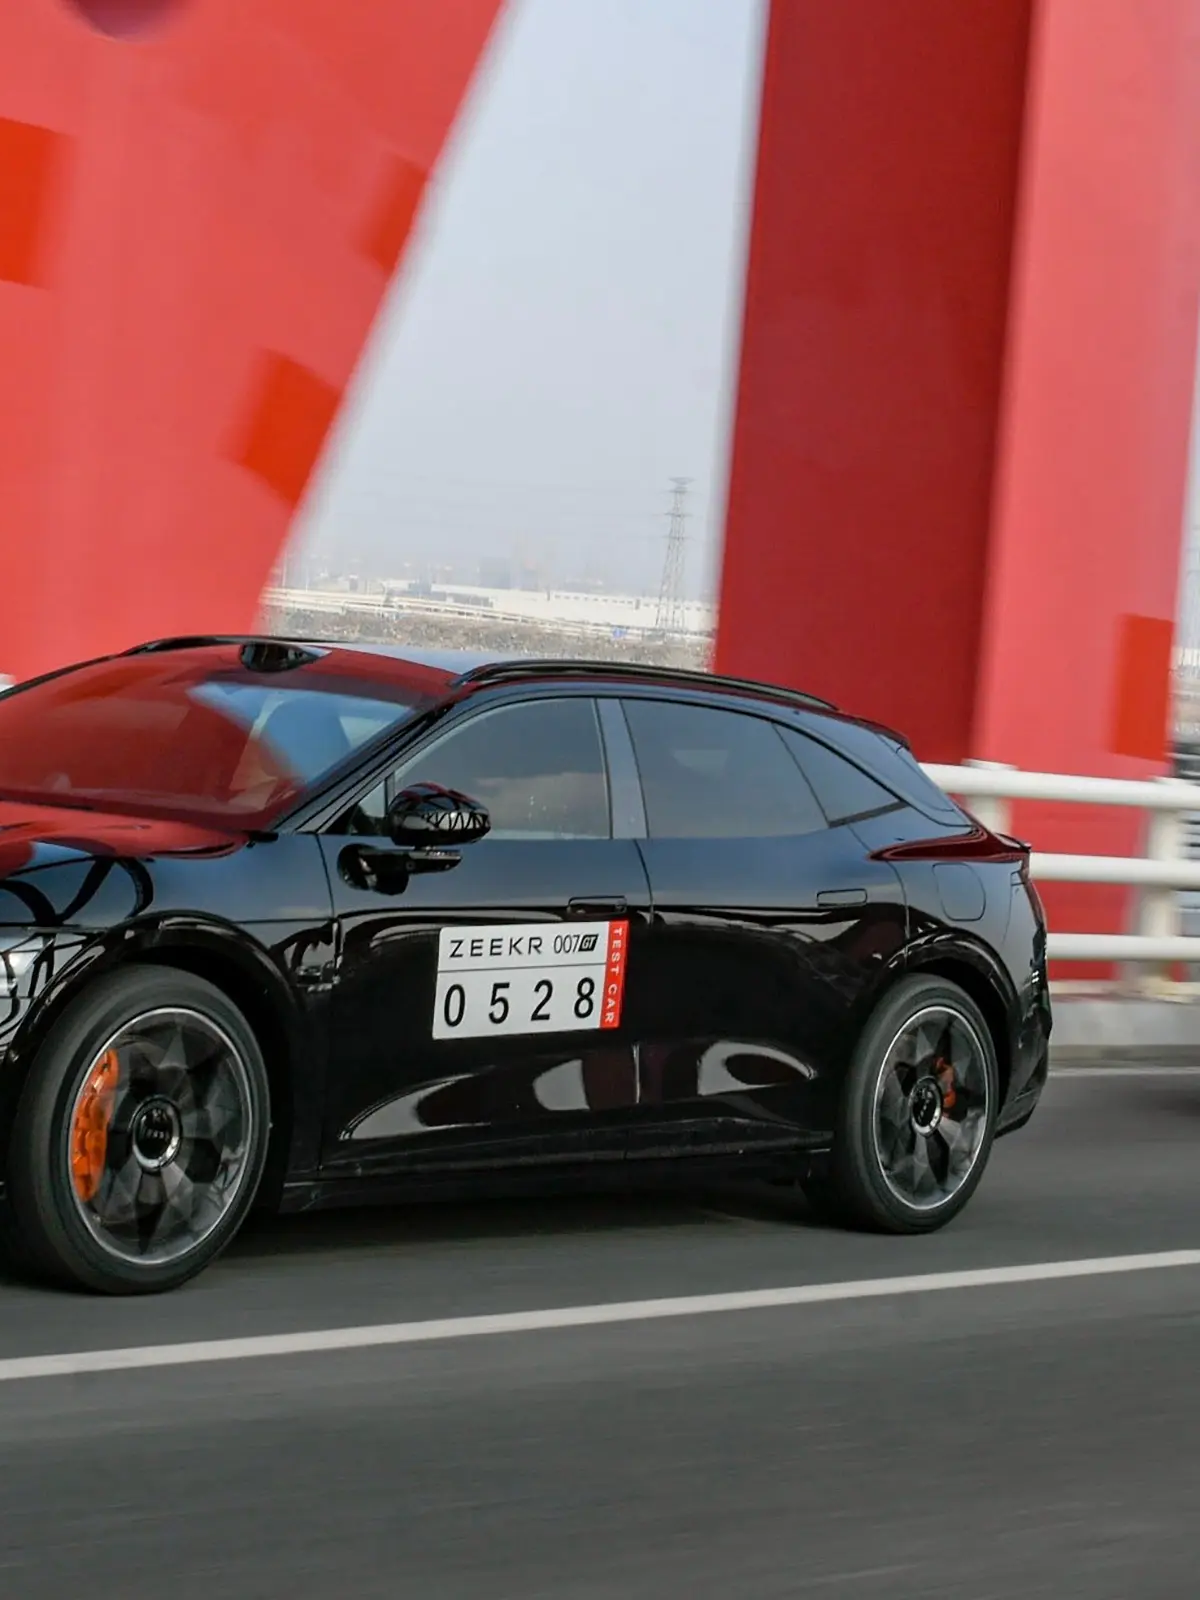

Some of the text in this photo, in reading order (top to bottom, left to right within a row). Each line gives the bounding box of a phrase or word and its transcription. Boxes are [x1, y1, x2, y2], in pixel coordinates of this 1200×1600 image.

[449, 936, 543, 958] ZEEKR
[604, 927, 623, 1023] TEST CAR
